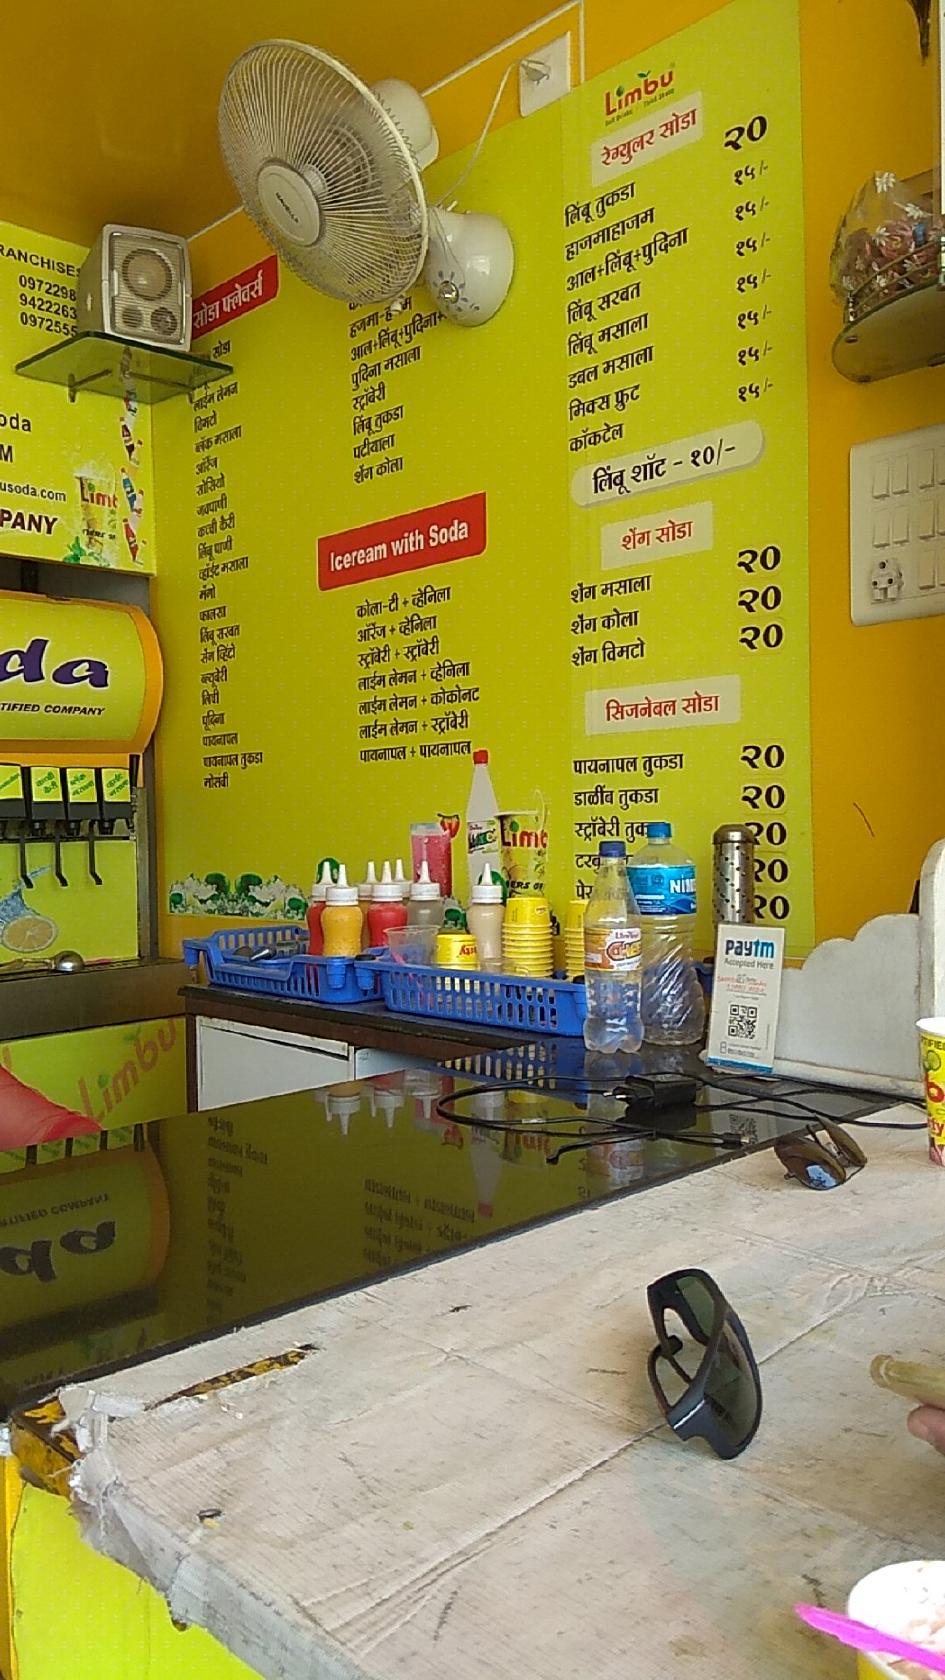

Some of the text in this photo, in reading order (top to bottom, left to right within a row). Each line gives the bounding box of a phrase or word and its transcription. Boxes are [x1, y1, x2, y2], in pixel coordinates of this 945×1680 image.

[605, 69, 674, 116] Limbu
[660, 108, 697, 138] सोडा
[565, 182, 635, 227] लिंबू तुकडा
[194, 270, 263, 329] सोडा फ्लेवर्स
[567, 299, 597, 325] लिंबू
[568, 312, 649, 356] लिंबू मसाला
[351, 346, 421, 392] पुदिना मसाला
[602, 345, 654, 375] मसाला
[353, 404, 403, 436] लिंबू तुकडा
[569, 394, 610, 421] मिक्स
[214, 425, 242, 445] मसाला
[569, 422, 624, 452] कॉकटेल
[376, 456, 403, 477] कोला
[592, 465, 631, 495] लिंबू
[631, 453, 667, 483] शॉट
[0, 509, 58, 535] PANY
[655, 520, 693, 544] सोडा
[330, 519, 469, 572] Iceream with Soda
[221, 556, 249, 573] मसाला
[601, 574, 651, 596] मसाला
[356, 593, 399, 619] कोला-टी
[601, 608, 639, 631] कोला
[602, 637, 645, 663] विमटो
[389, 667, 417, 686] लेमन
[44, 704, 105, 716] COMPANY
[389, 692, 417, 711] लेमन
[430, 684, 480, 707] कोकोनट
[606, 691, 720, 722] सिजनेबल सोडा
[390, 716, 418, 736] लेमन
[360, 745, 406, 763] पायनापल
[419, 740, 471, 757] पायनापल
[573, 753, 684, 777] पायनापल तुकडा
[618, 787, 659, 810] तुकडा
[724, 957, 774, 970] Accepted Here
